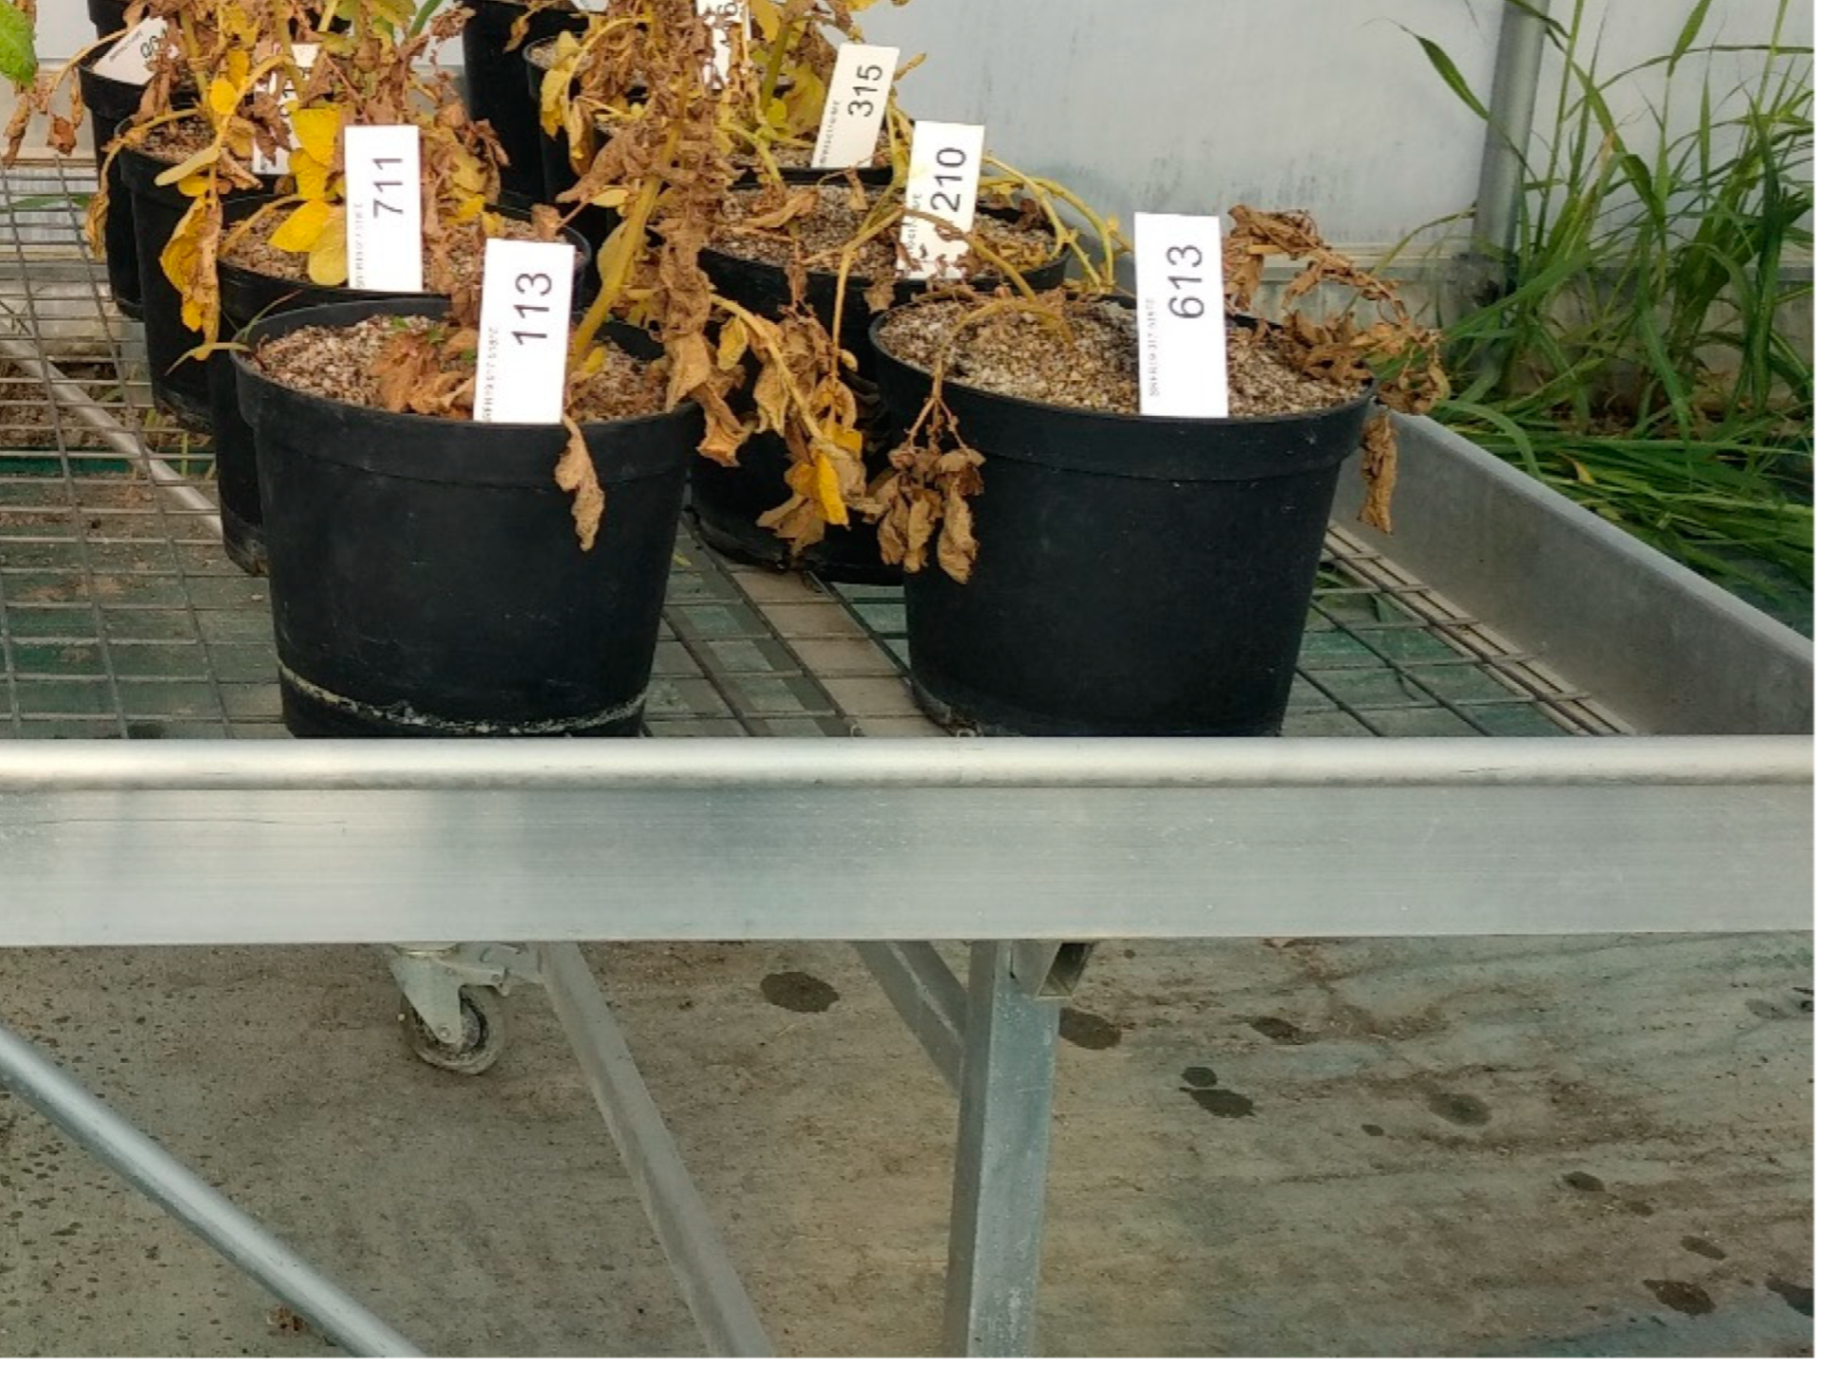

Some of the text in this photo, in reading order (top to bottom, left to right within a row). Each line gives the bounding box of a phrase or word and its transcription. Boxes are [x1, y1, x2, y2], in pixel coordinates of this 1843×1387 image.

[847, 63, 883, 118] 315
[373, 157, 403, 221] 711
[931, 146, 966, 214] 210
[511, 272, 552, 347] 113
[1167, 243, 1204, 320] 613
